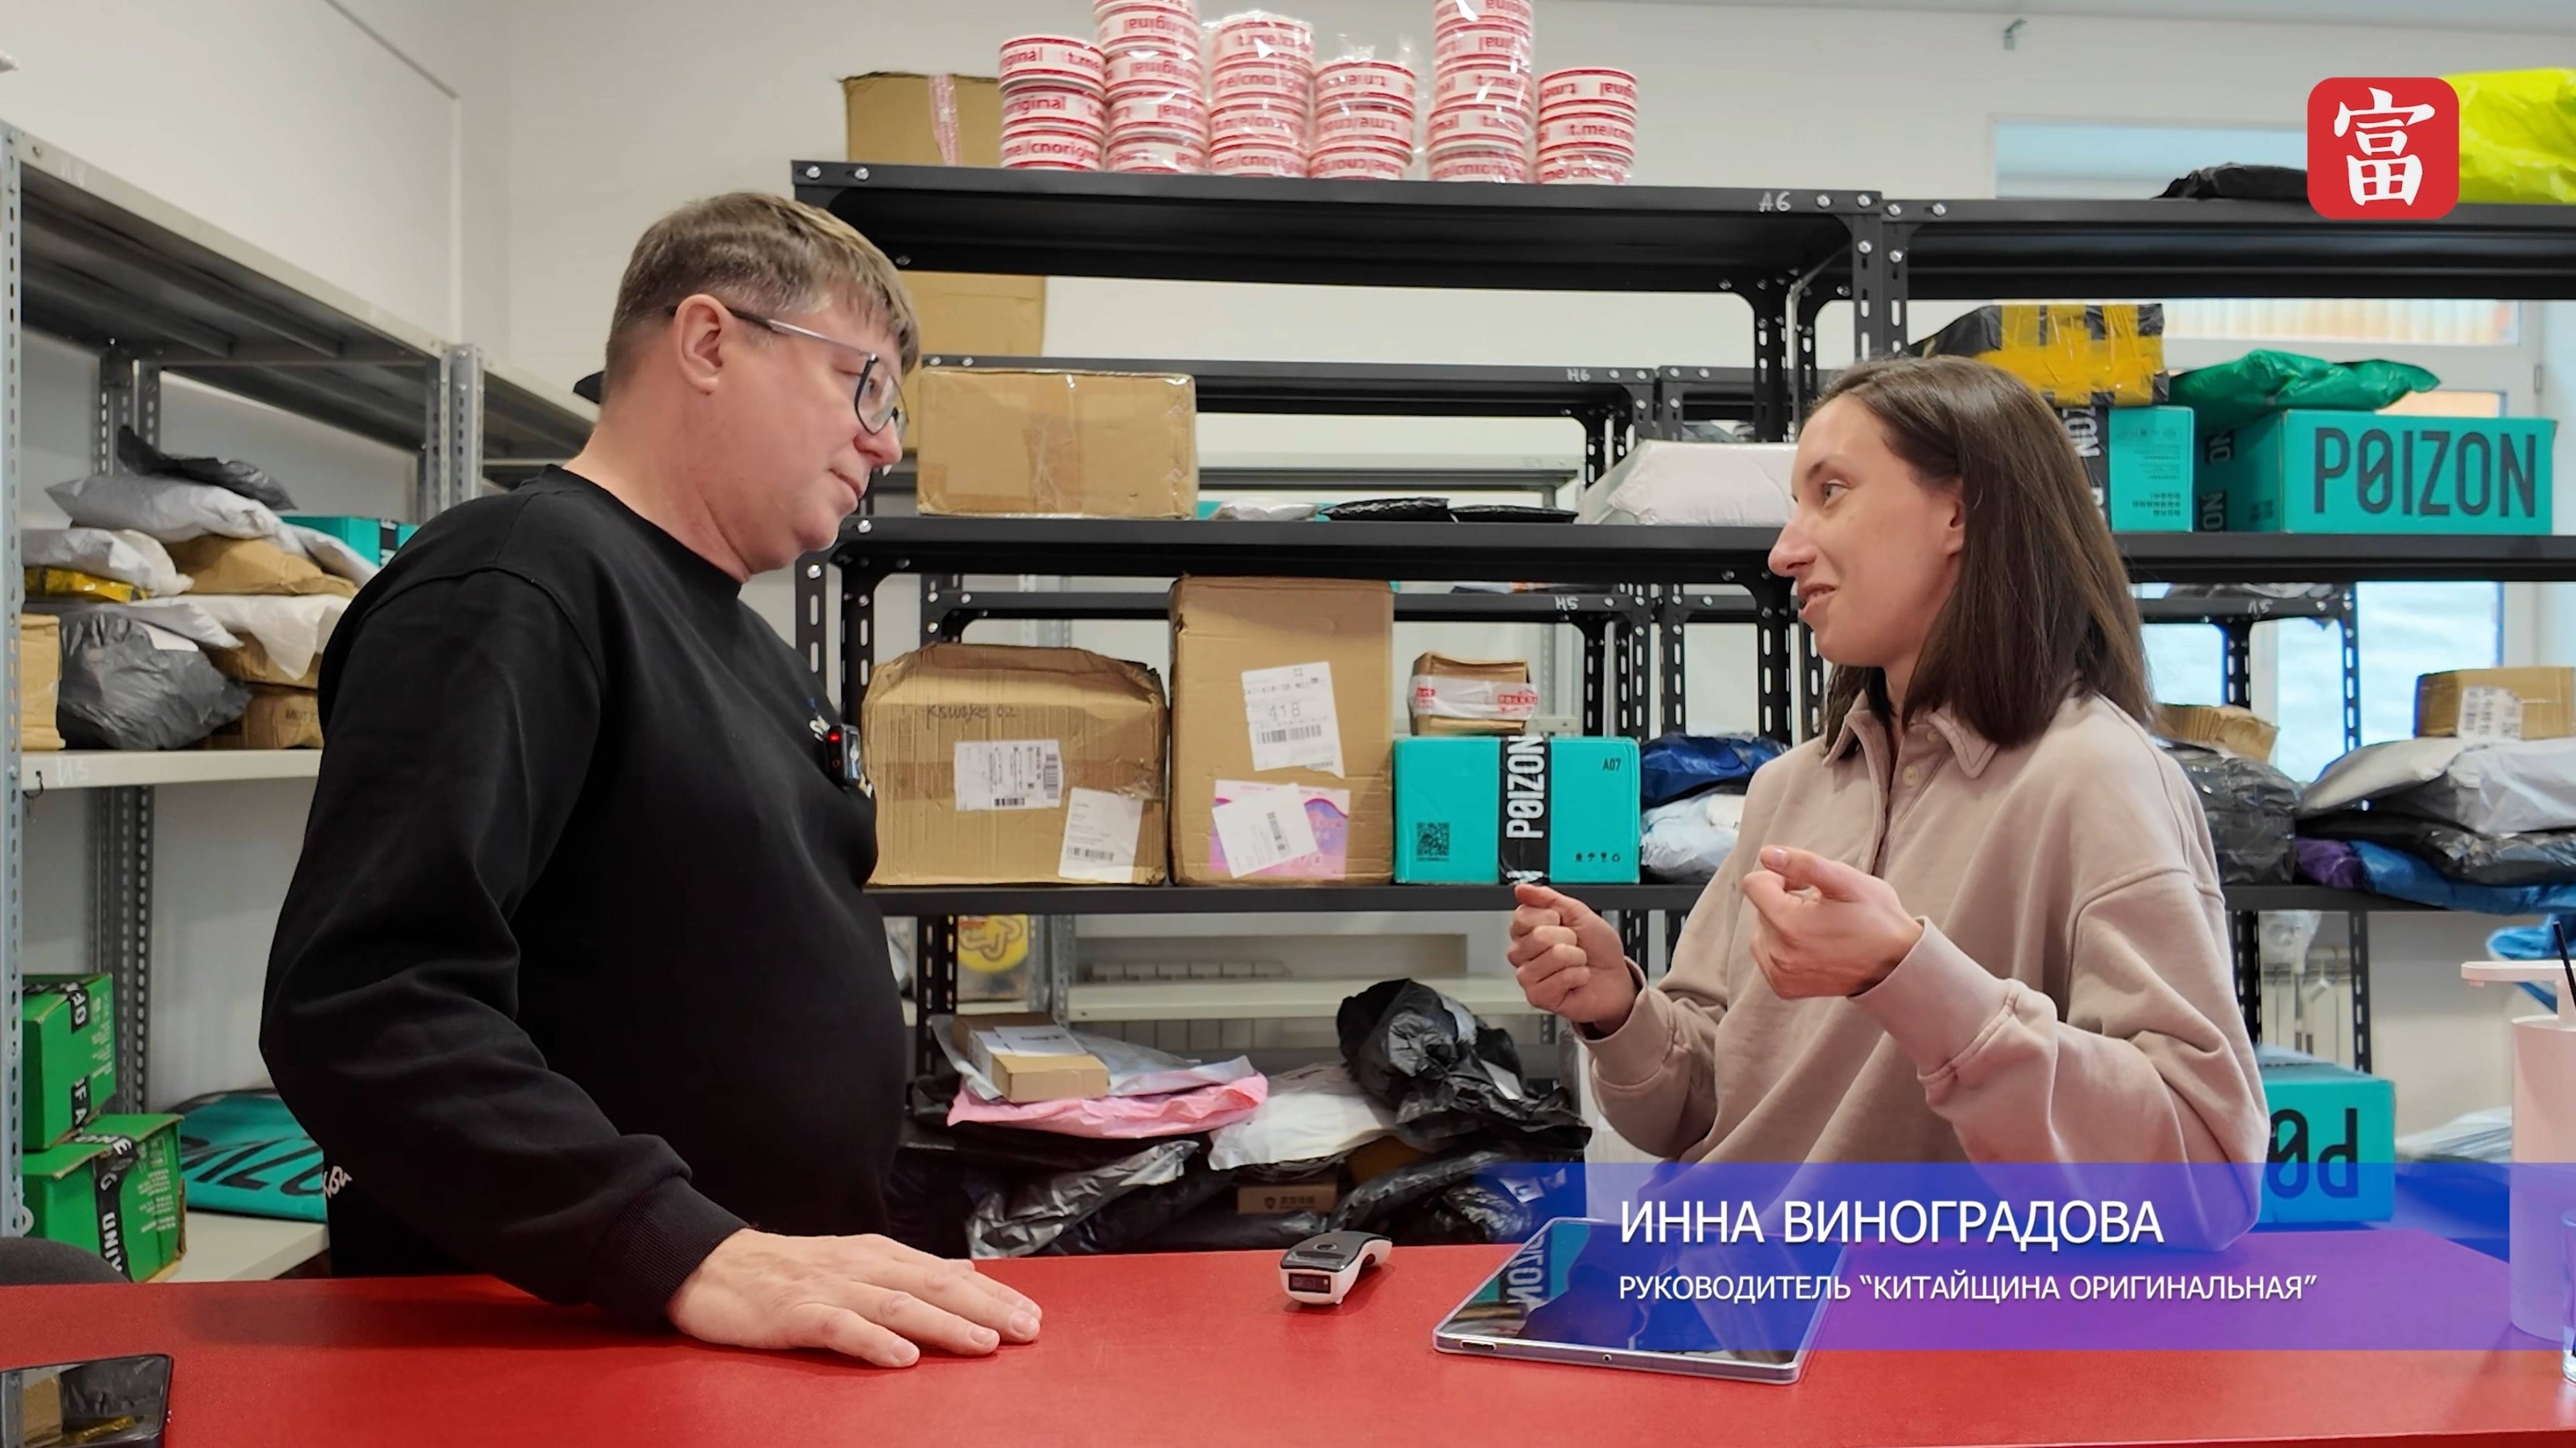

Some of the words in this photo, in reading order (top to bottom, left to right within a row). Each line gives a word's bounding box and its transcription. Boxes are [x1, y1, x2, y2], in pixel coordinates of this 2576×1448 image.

[1759, 191, 1791, 213] A6
[1566, 368, 1591, 382] H6
[1554, 595, 1579, 612] H5
[1268, 702, 1301, 720] 418
[1602, 758, 1621, 771] A07
